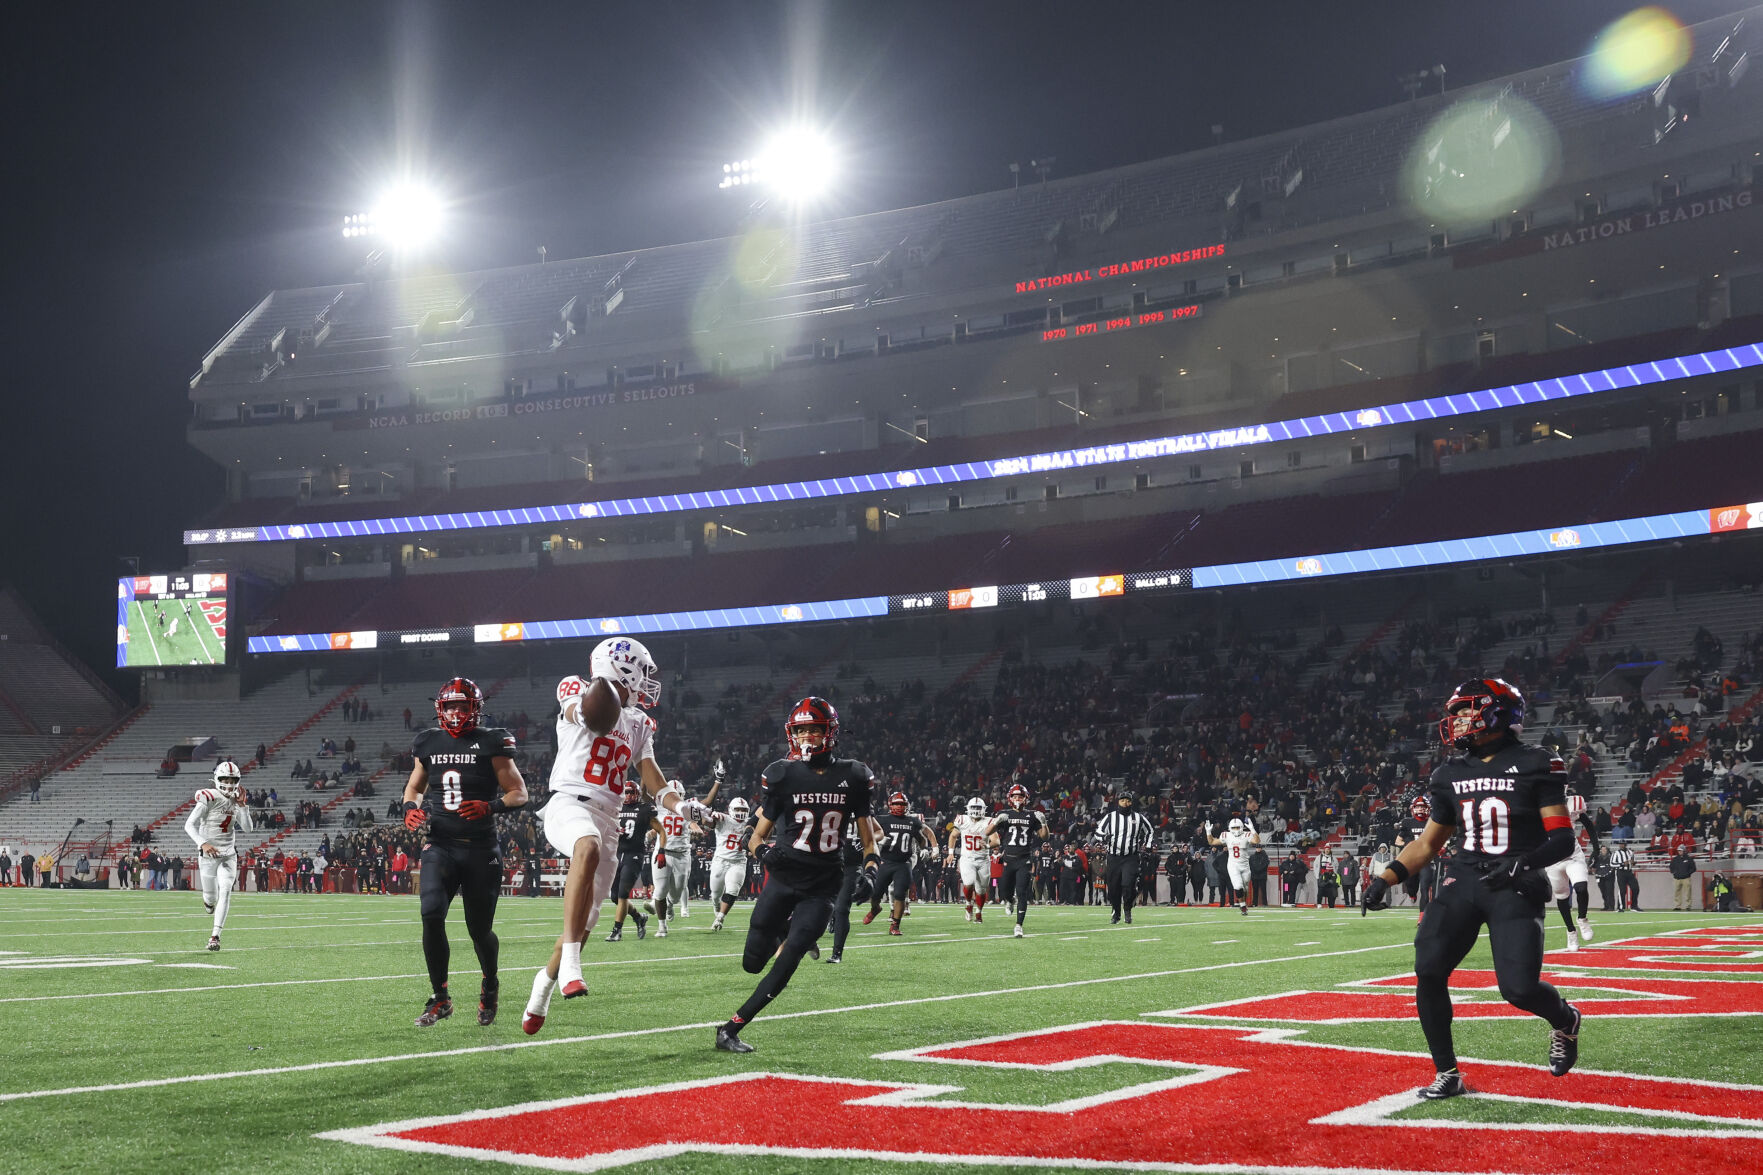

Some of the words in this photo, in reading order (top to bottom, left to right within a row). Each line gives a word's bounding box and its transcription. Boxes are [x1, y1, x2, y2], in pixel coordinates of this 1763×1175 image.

[1543, 217, 1632, 250] NATION
[1645, 191, 1753, 228] LEADING
[1015, 269, 1092, 293] NATIONAL
[1098, 244, 1225, 277] CHAMPIONSHIPS
[1043, 328, 1066, 341] 1970
[1075, 323, 1098, 336] 1971
[1106, 317, 1131, 330] 1994
[1139, 311, 1164, 324] 1995
[1172, 305, 1198, 319] 1997
[369, 415, 409, 429] NCAA
[415, 408, 472, 425] RECORD
[514, 392, 616, 414] CONSECUTIVE
[623, 383, 695, 402] SELLOUTS
[1076, 446, 1125, 466] STATE
[1128, 434, 1206, 458] FOOTBALL
[1208, 426, 1269, 449] FINALS
[559, 681, 581, 699] 88
[430, 754, 477, 765] WESTSIDE
[583, 736, 631, 795] 88
[442, 770, 463, 811] 8
[793, 792, 847, 805] WESTSIDE
[1452, 777, 1515, 794] WESTSIDE
[219, 815, 232, 833] 4
[663, 816, 684, 836] 66
[792, 809, 843, 853] 28
[1460, 796, 1510, 855] 10
[889, 832, 910, 852] 70
[965, 834, 983, 851] 50
[1232, 846, 1240, 858] 8
